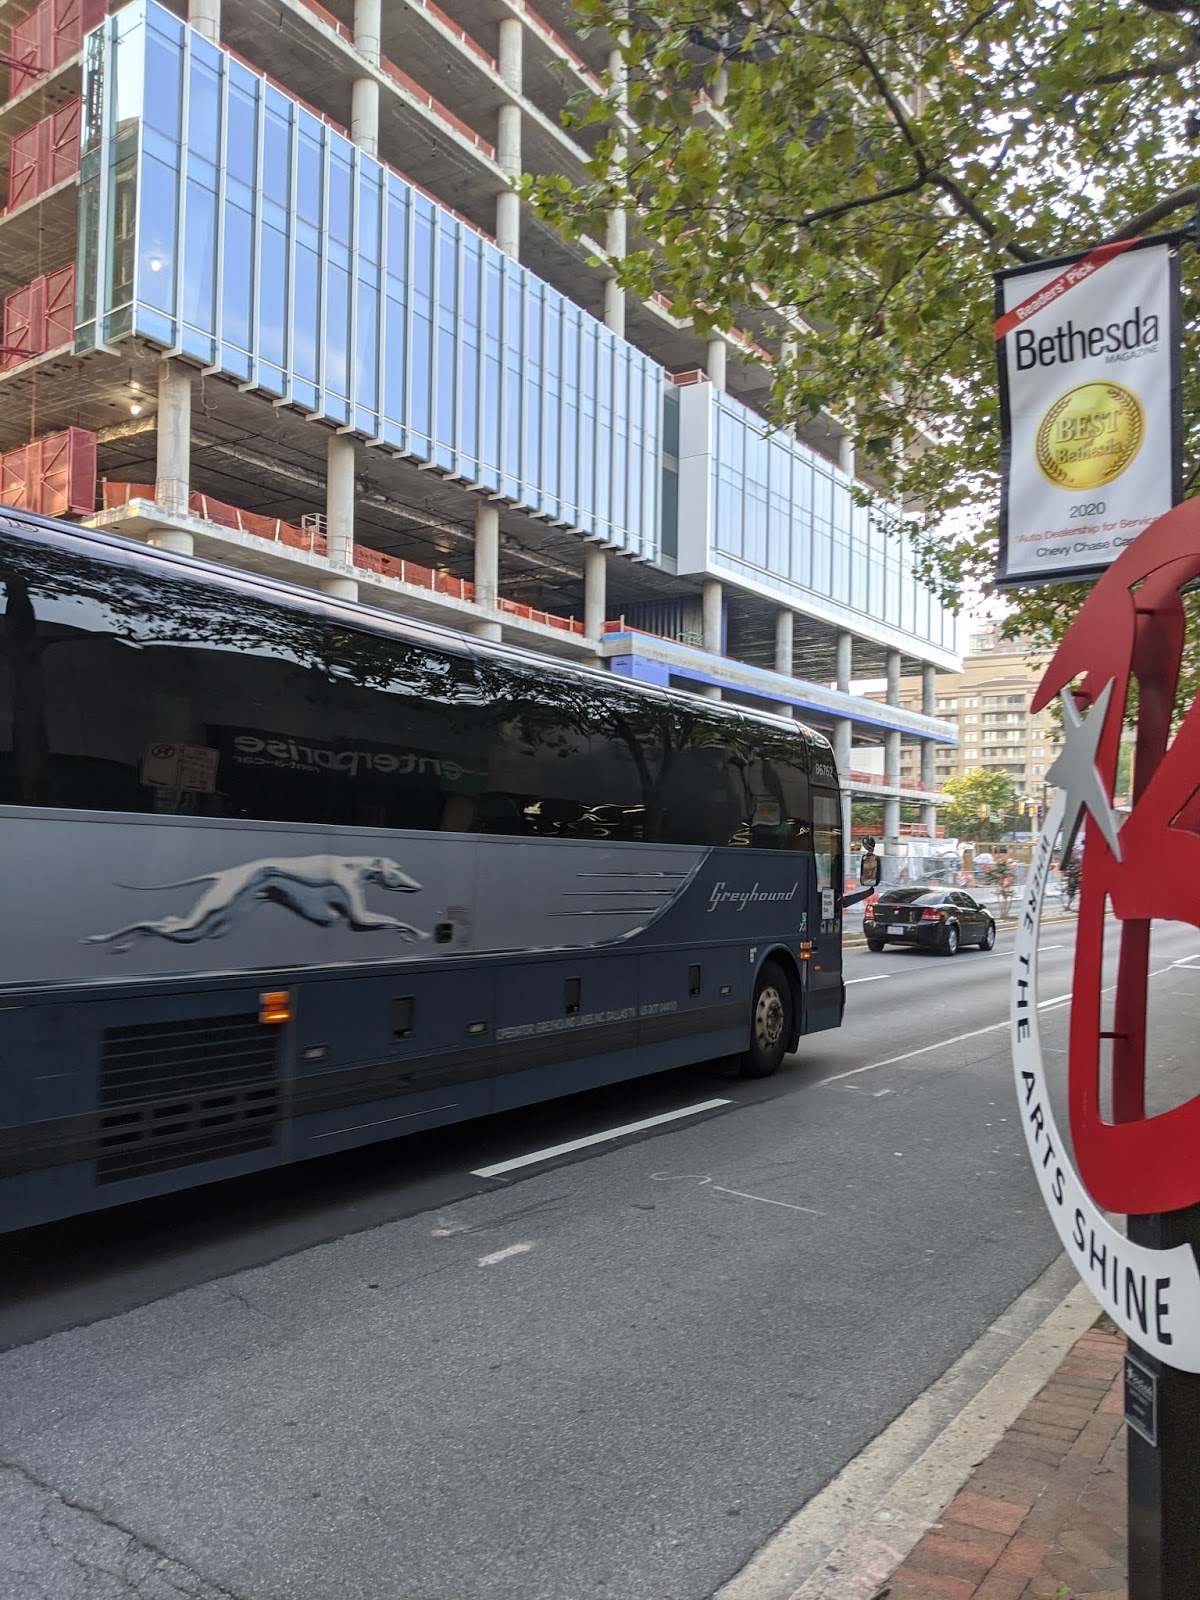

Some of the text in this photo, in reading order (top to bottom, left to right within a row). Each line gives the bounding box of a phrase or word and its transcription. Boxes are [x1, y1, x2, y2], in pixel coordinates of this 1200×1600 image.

[1015, 262, 1096, 320] Readers' Pick
[1015, 306, 1160, 371] Bethesda
[1104, 342, 1160, 365] MAGAZINE
[1056, 410, 1120, 443] BEST
[1069, 501, 1106, 519] 2020
[1044, 523, 1101, 540] Dealership
[1102, 521, 1118, 533] for
[1036, 544, 1072, 558] Chevy
[1074, 540, 1111, 553] Chase
[707, 880, 800, 912] Greyhound
[1016, 954, 1031, 1043] THE
[1020, 1070, 1067, 1206] ARTS
[1072, 1207, 1173, 1346] SHINE
